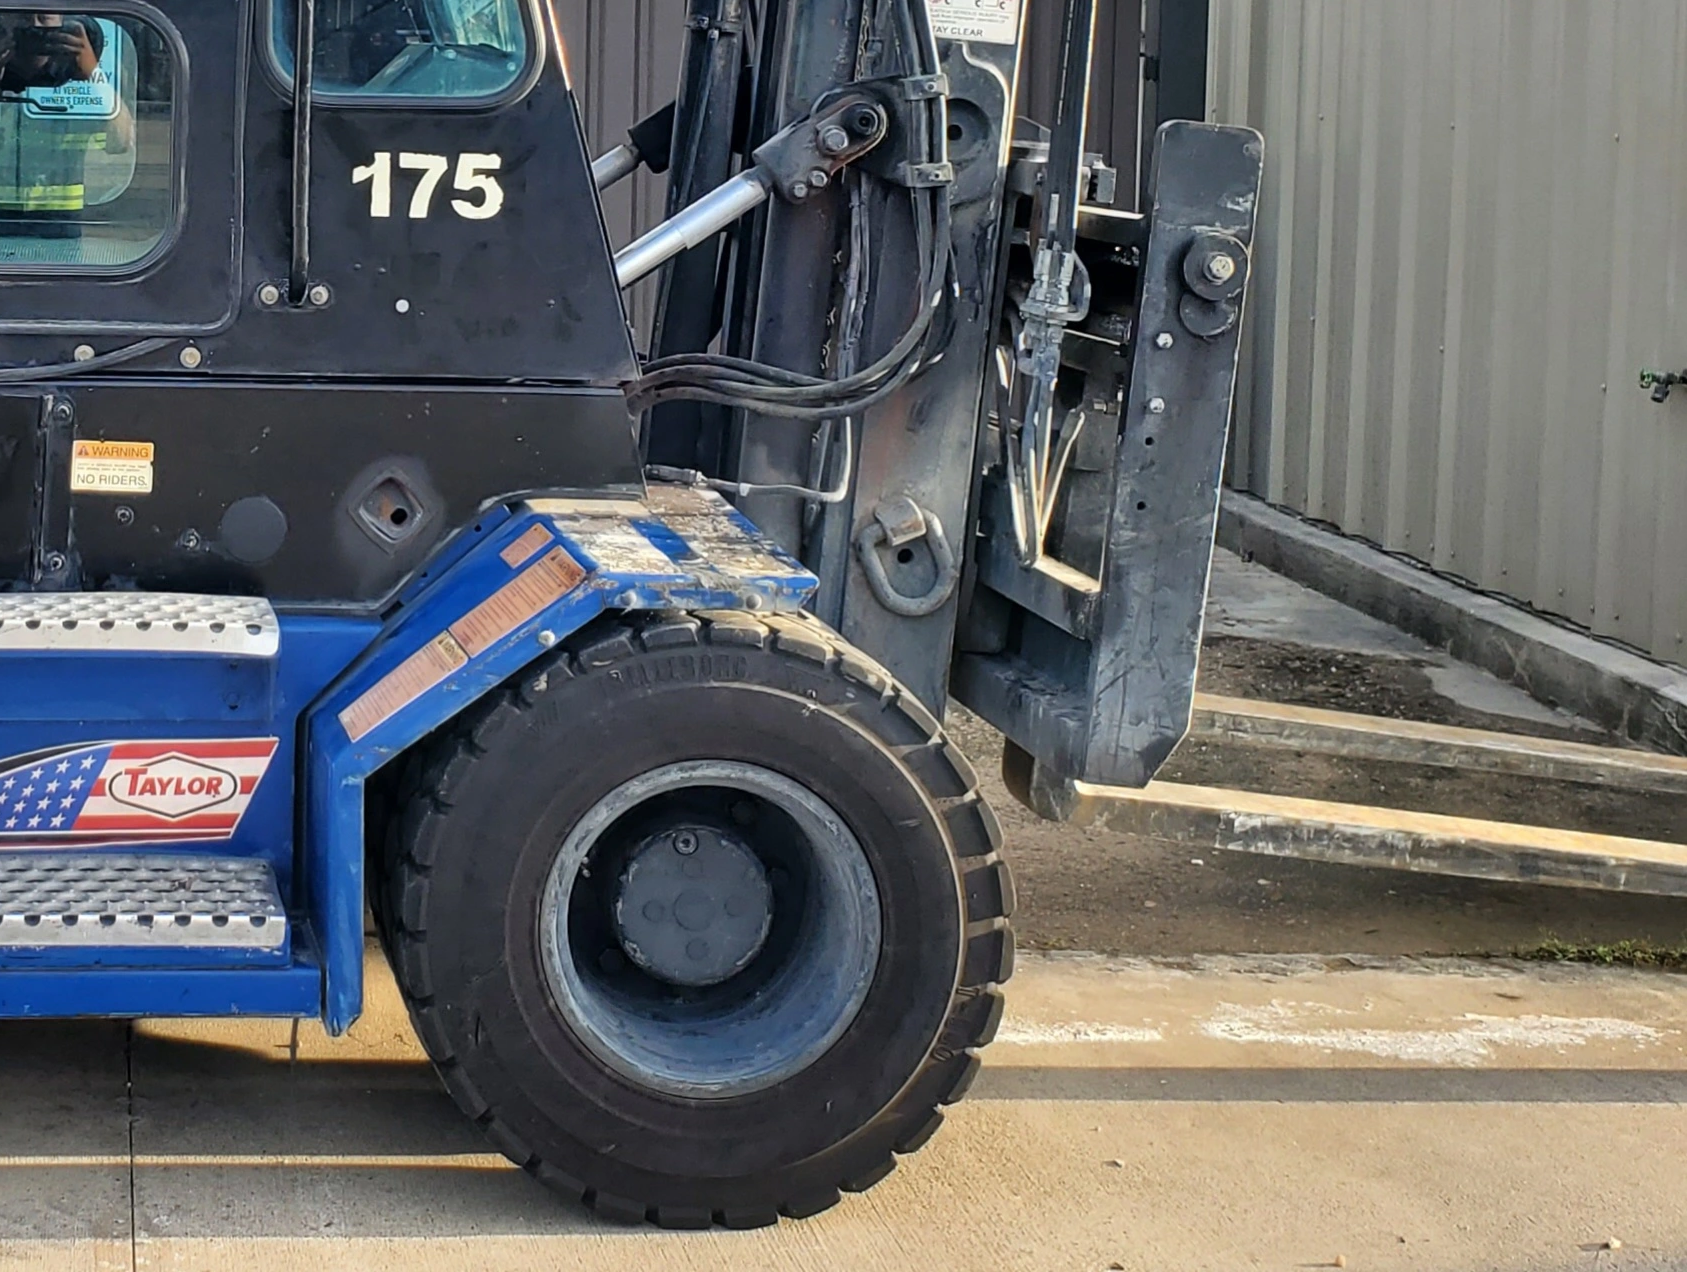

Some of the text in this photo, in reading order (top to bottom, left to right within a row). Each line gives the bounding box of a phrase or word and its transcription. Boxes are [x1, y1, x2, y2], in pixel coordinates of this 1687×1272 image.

[931, 25, 983, 37] TAY CLEAR
[63, 86, 91, 96] VEHICLE
[40, 96, 103, 106] OWNER'S EXPENSE
[351, 151, 505, 220] 175
[92, 446, 149, 458] WARNING
[76, 474, 95, 484] NO
[124, 766, 224, 796] TAYLOR
